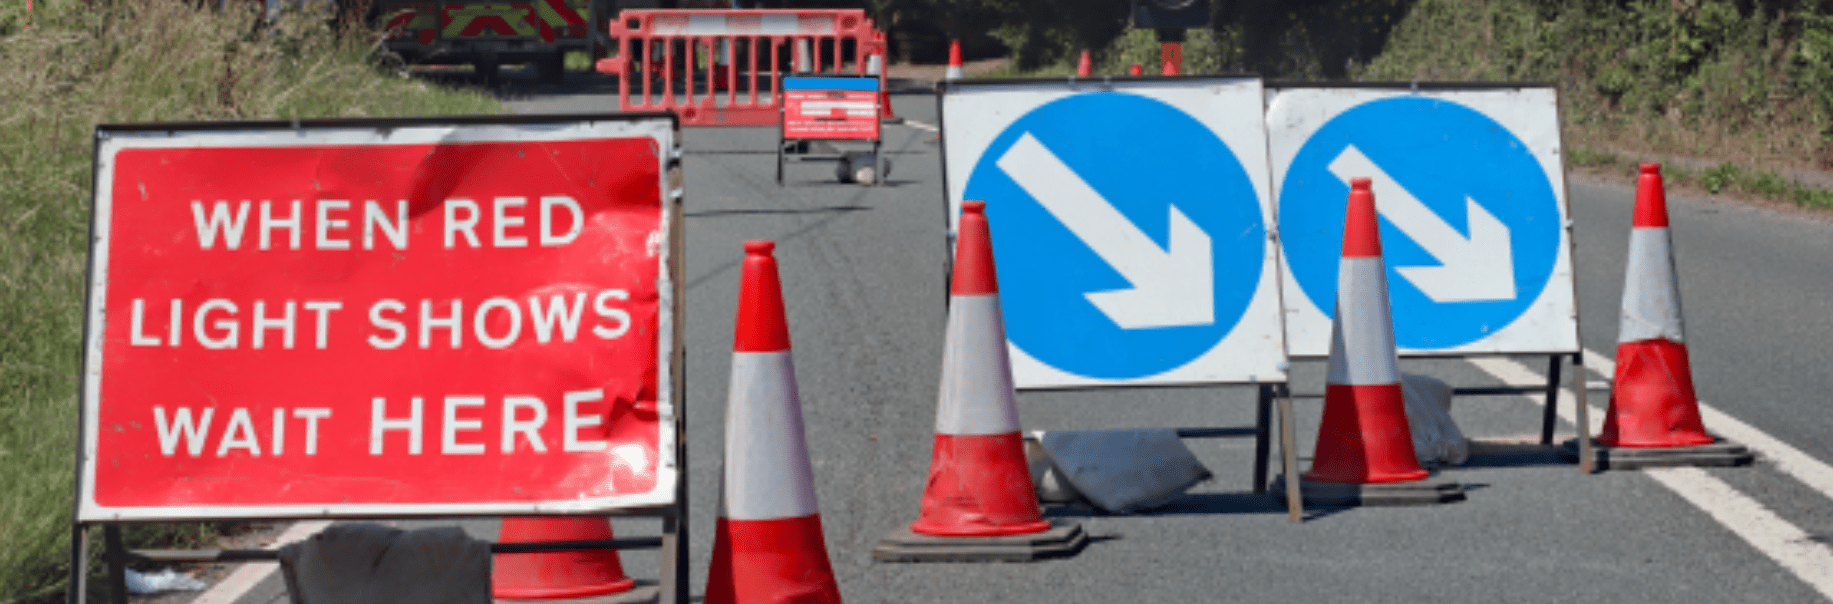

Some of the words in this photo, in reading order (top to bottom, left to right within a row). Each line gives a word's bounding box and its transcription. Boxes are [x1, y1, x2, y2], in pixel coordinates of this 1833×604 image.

[191, 199, 410, 251] WHEN
[443, 195, 585, 249] RED
[130, 298, 344, 350] LIGHT
[367, 288, 632, 350] SHOWS
[153, 406, 332, 458] WAIT
[369, 388, 609, 456] HERE
